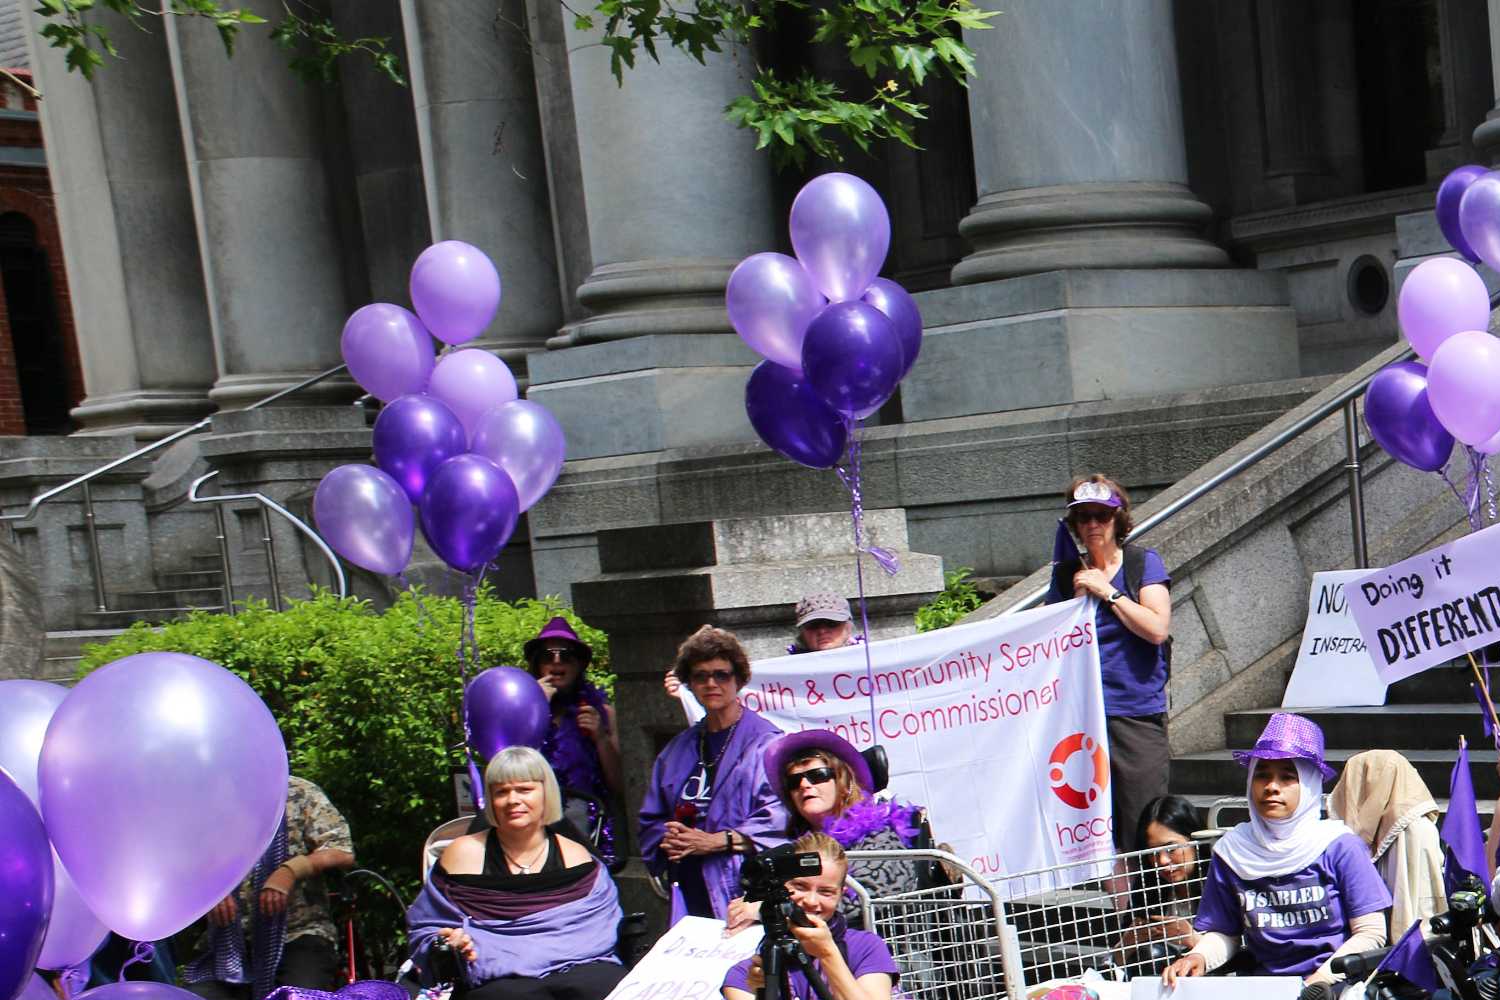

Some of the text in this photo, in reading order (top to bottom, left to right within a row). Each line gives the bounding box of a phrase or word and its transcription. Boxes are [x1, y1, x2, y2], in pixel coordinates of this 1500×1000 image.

[1361, 554, 1452, 607] Doing it
[744, 620, 1093, 712] alth & Community Services
[879, 677, 1061, 740] Commissioner
[1257, 906, 1329, 928] PROUD!
